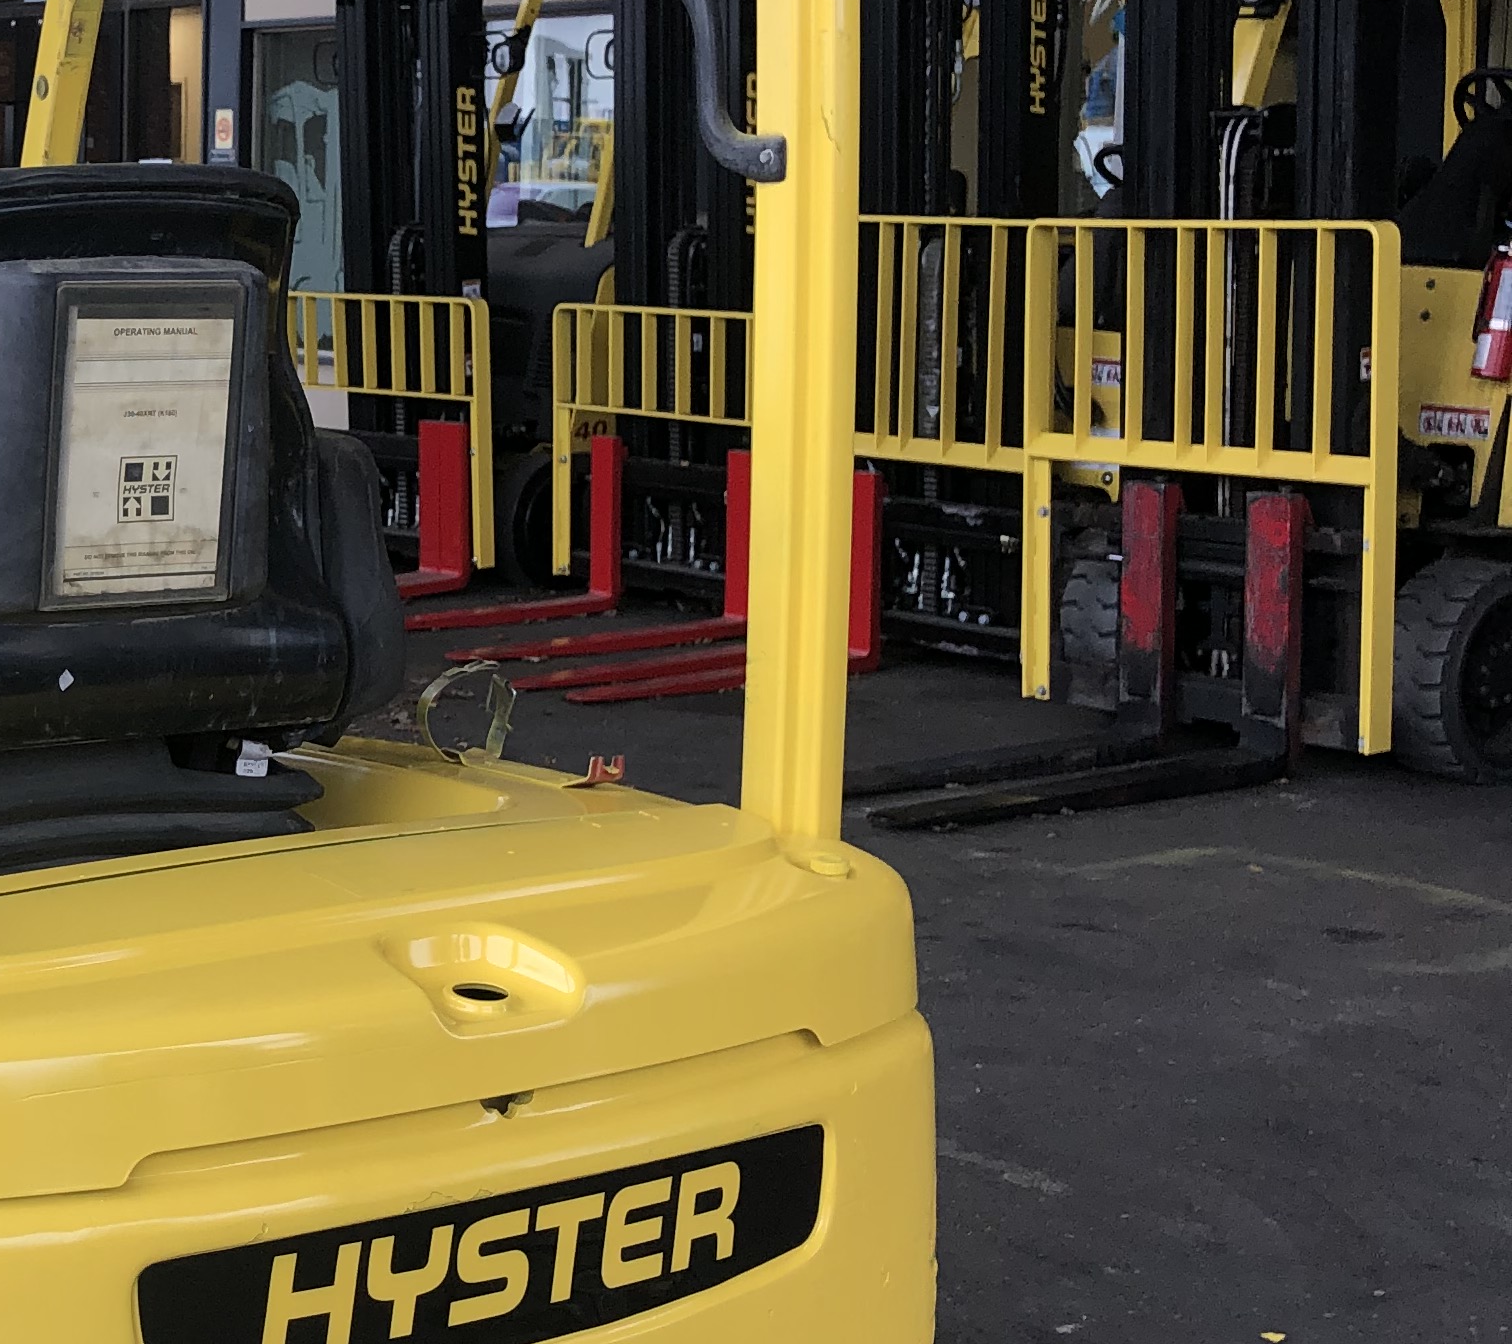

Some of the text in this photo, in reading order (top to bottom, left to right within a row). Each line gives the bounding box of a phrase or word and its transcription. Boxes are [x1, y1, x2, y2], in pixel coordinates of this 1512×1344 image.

[456, 86, 478, 236] HYSTER
[113, 327, 198, 336] OPERATING MANUAL
[123, 483, 170, 494] HYSTER
